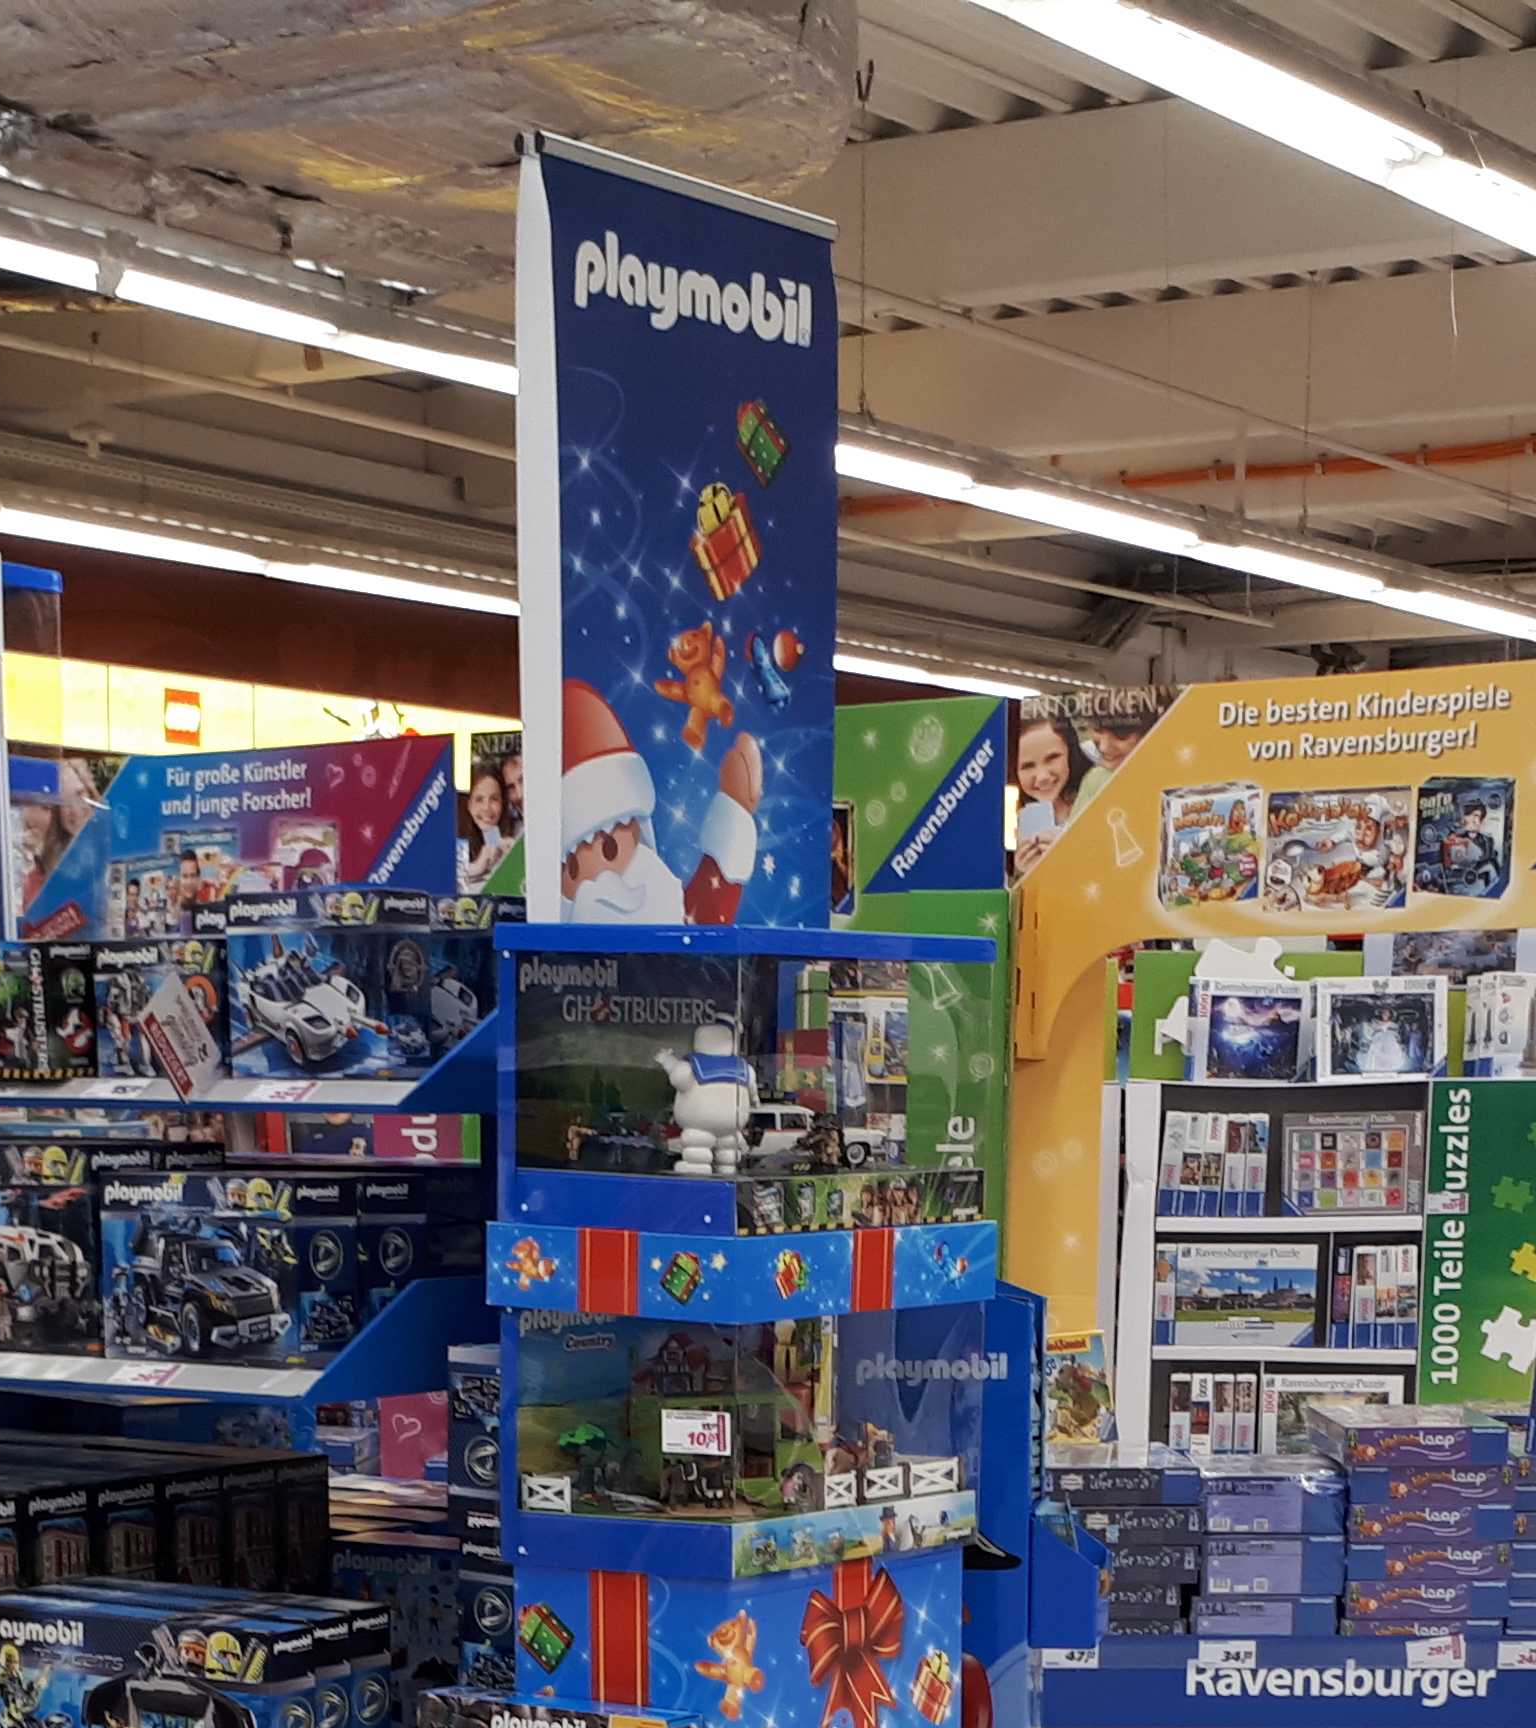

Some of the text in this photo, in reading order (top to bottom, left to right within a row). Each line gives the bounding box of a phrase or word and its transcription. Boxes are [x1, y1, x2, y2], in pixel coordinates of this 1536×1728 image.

[574, 231, 812, 347] playmobil
[1219, 684, 1511, 728] Die besten Kinderspiele
[1247, 722, 1478, 761] von Ravensburger!
[166, 760, 308, 795] Für große Künstler
[161, 787, 313, 820] und junge Forscher!
[891, 737, 996, 880] Ravensburger
[230, 900, 298, 920] playmobil
[519, 958, 619, 993] playmobil
[562, 994, 717, 1025] GHOSTBUSTERS
[104, 1181, 184, 1206] playmobil
[1430, 1087, 1473, 1386] 1000 Teile uzzles
[855, 1353, 1009, 1384] playmobil
[28, 1490, 88, 1517] playmobil
[98, 1483, 155, 1507] playmobil
[332, 1550, 432, 1576] playmobil
[1185, 1659, 1498, 1708] Ravensburger
